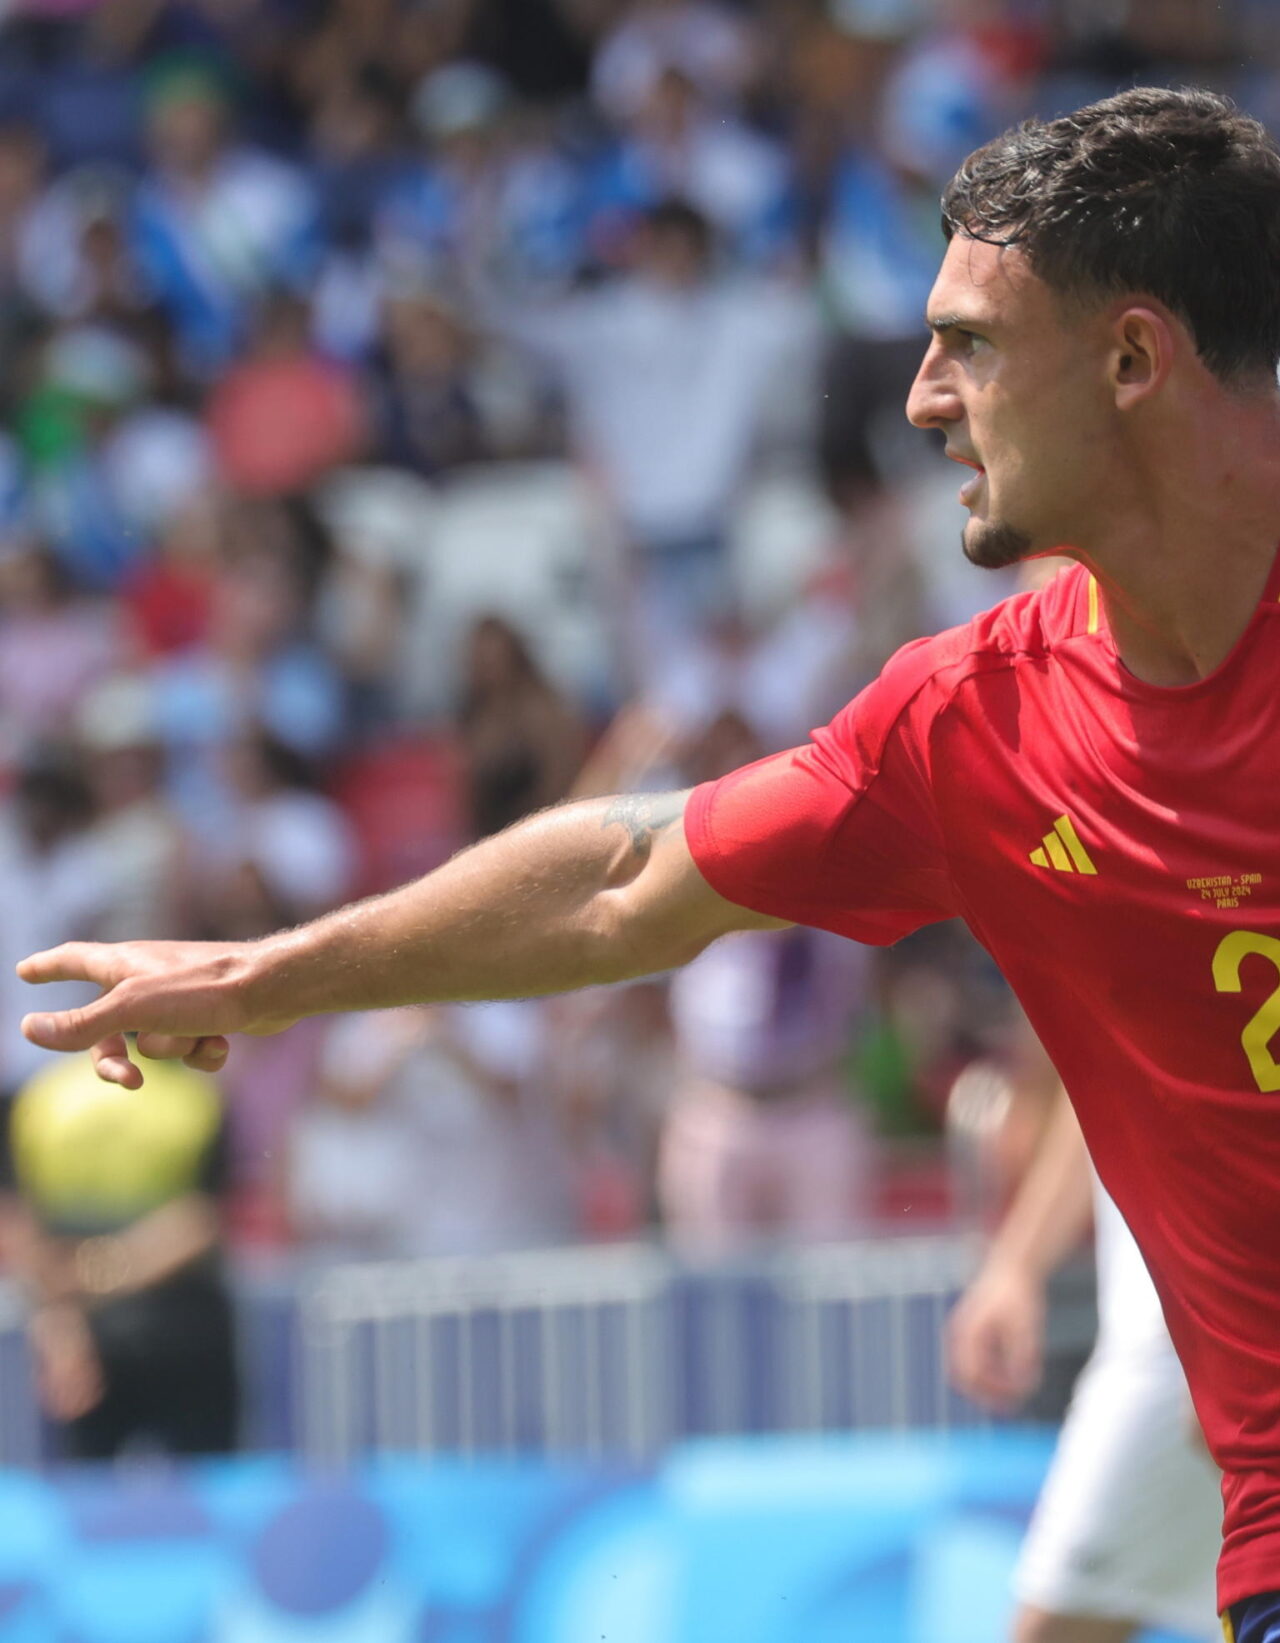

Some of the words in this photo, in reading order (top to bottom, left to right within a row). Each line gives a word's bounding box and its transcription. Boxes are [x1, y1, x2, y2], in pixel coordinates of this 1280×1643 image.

[1186, 875, 1232, 889] UZBEKISTAN
[1240, 873, 1262, 885] SPAIN
[1201, 888, 1211, 899] 24
[1213, 887, 1229, 898] JULY
[1232, 886, 1251, 897] 2024
[1216, 897, 1239, 909] PARIS
